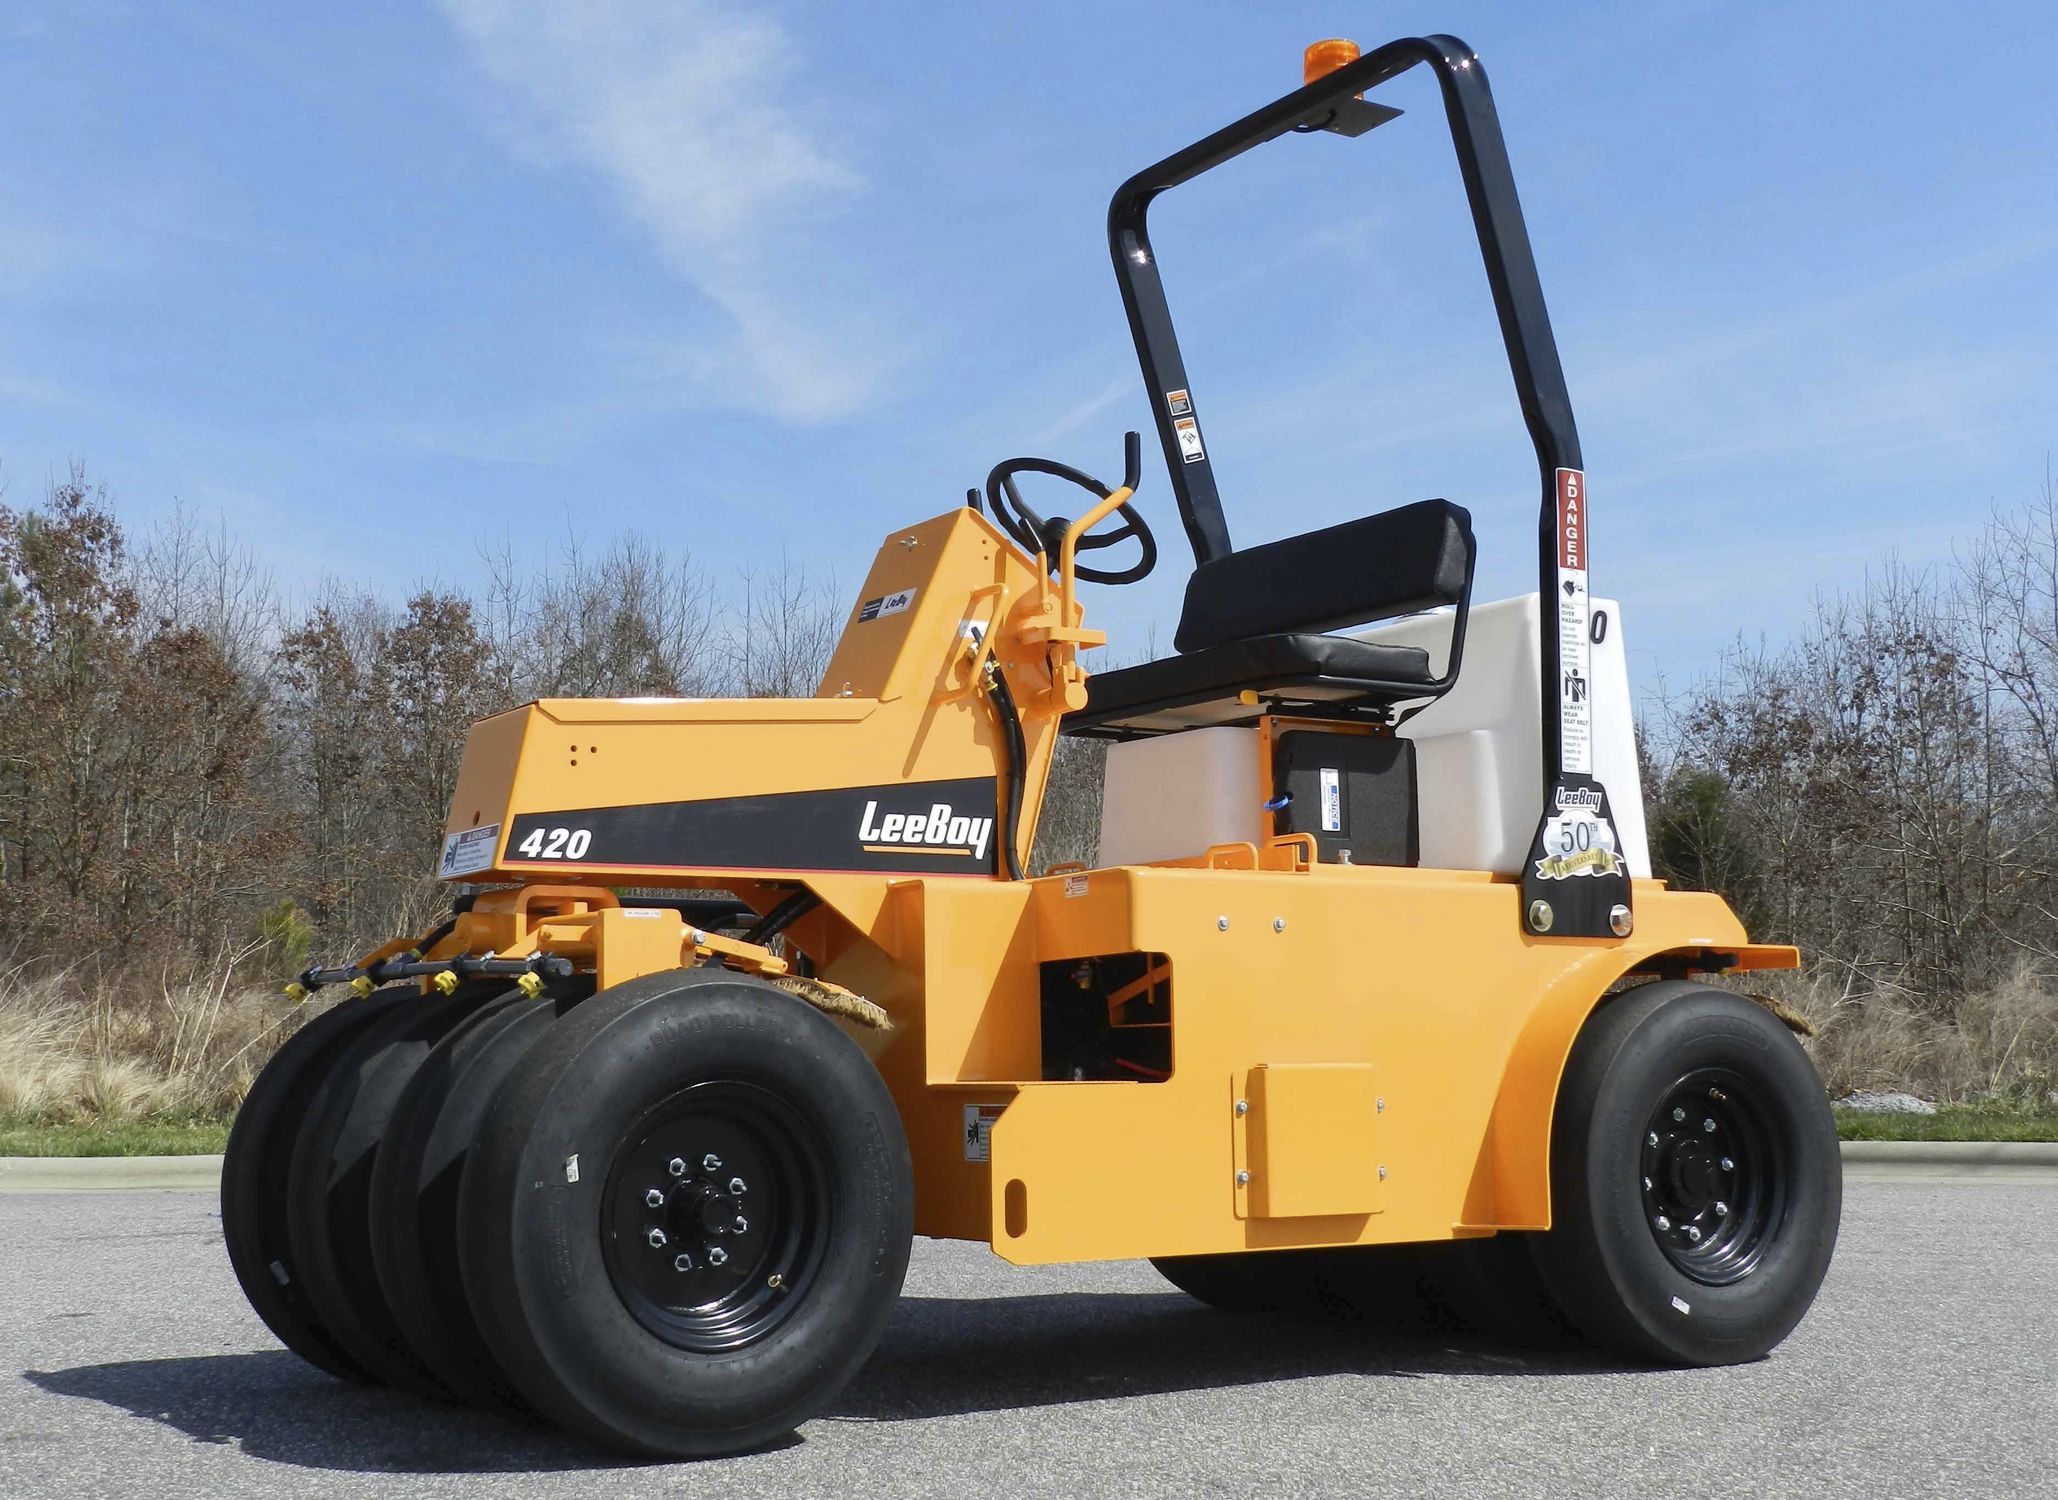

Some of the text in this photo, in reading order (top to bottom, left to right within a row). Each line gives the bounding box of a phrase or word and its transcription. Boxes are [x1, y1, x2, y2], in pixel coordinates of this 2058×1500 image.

[1565, 484, 1578, 567] DANGER
[1557, 789, 1599, 810] LeeBoy
[518, 827, 593, 860] 420
[859, 801, 993, 860] LeeBoy
